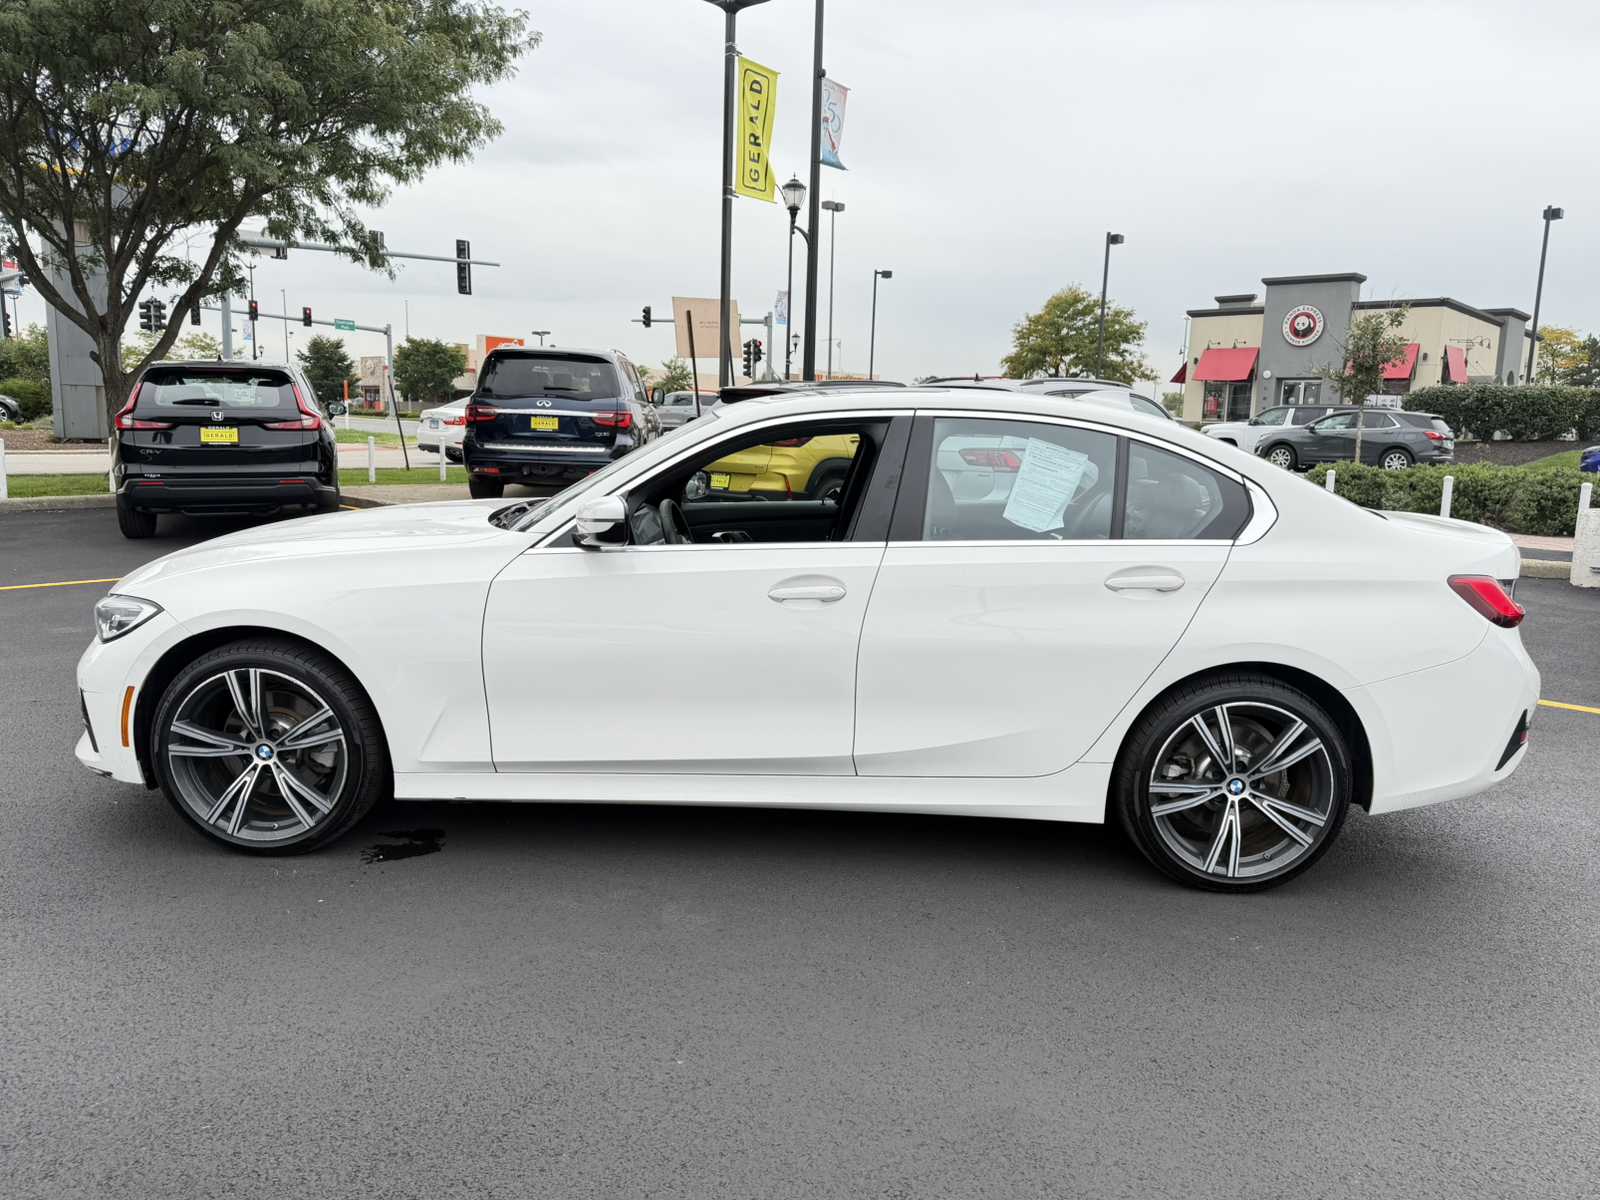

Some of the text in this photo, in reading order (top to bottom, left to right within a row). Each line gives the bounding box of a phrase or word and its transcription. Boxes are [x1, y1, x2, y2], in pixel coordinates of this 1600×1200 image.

[749, 79, 762, 183] GERALD
[1285, 306, 1323, 325] PANDA EXPRESS
